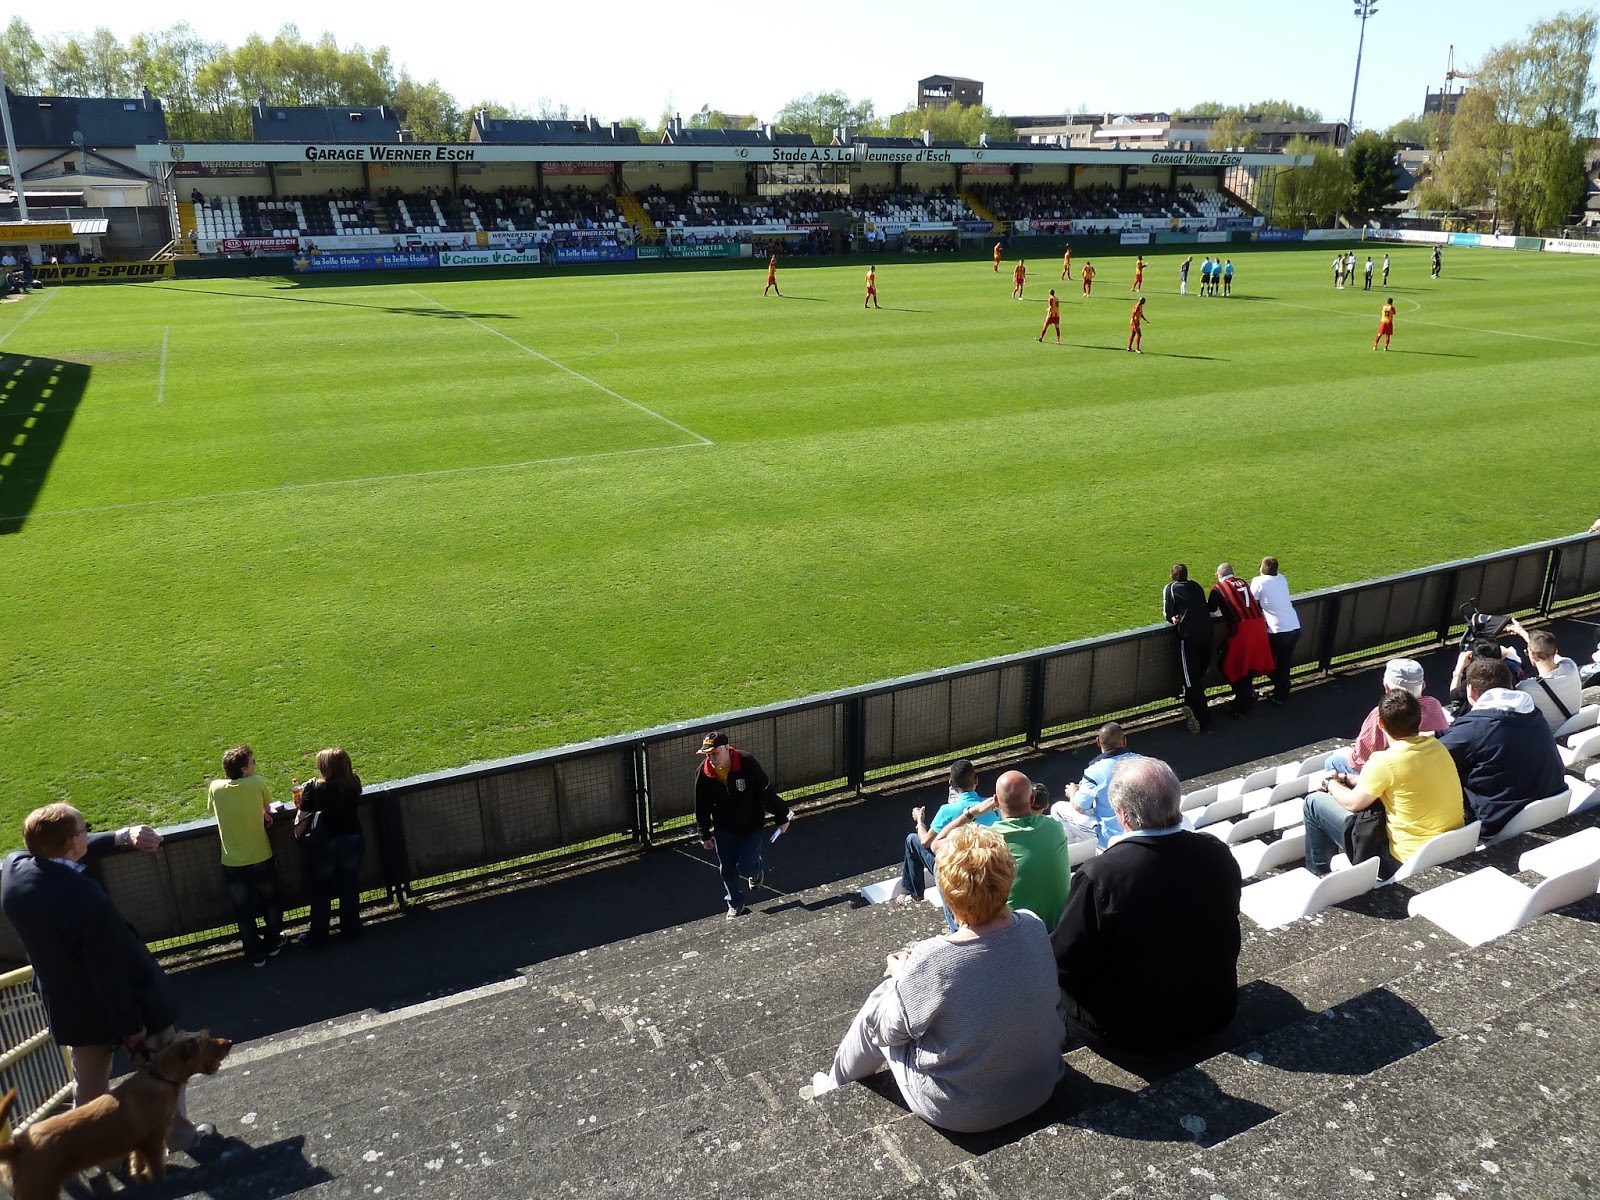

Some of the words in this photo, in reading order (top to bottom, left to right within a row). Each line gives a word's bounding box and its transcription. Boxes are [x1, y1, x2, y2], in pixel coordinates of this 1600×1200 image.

[305, 146, 364, 160] GARAGE
[370, 146, 431, 160] WERNER
[435, 146, 474, 160] ESCH
[772, 149, 807, 160] Stade
[810, 149, 834, 160] A.S.
[838, 150, 850, 160] La
[916, 150, 950, 162] d'Esch
[1152, 153, 1184, 164] GARAGE
[1185, 154, 1218, 164] WERNER
[1220, 154, 1242, 164] ESCH
[452, 256, 488, 264] Cactus
[503, 254, 538, 262] Cactus
[1236, 586, 1250, 608] 7
